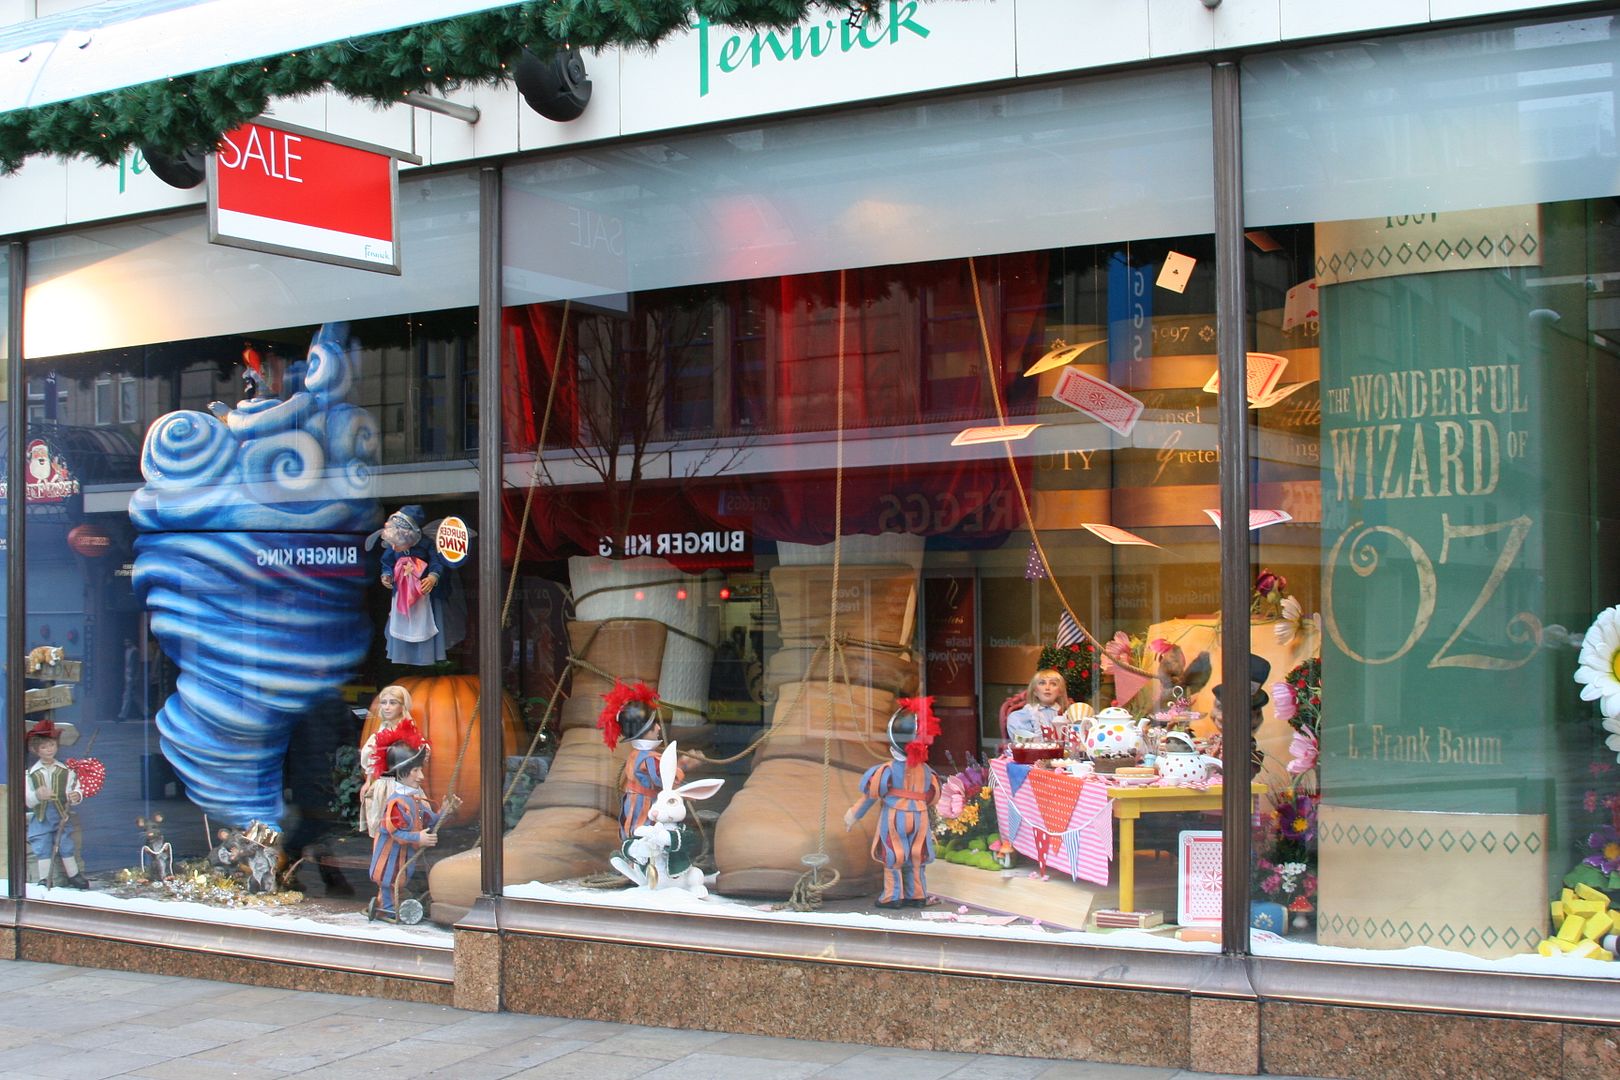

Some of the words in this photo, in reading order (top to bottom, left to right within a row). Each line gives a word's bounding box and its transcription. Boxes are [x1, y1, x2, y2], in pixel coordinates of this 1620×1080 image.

[219, 126, 303, 183] SALE
[1327, 387, 1350, 414] THE
[1350, 363, 1529, 423] WONDERFUL
[1328, 418, 1501, 502] WIZARD
[1507, 430, 1529, 458] OF
[1323, 512, 1544, 670] OZ
[1372, 724, 1432, 764] Frank
[1438, 725, 1504, 766] Baum
